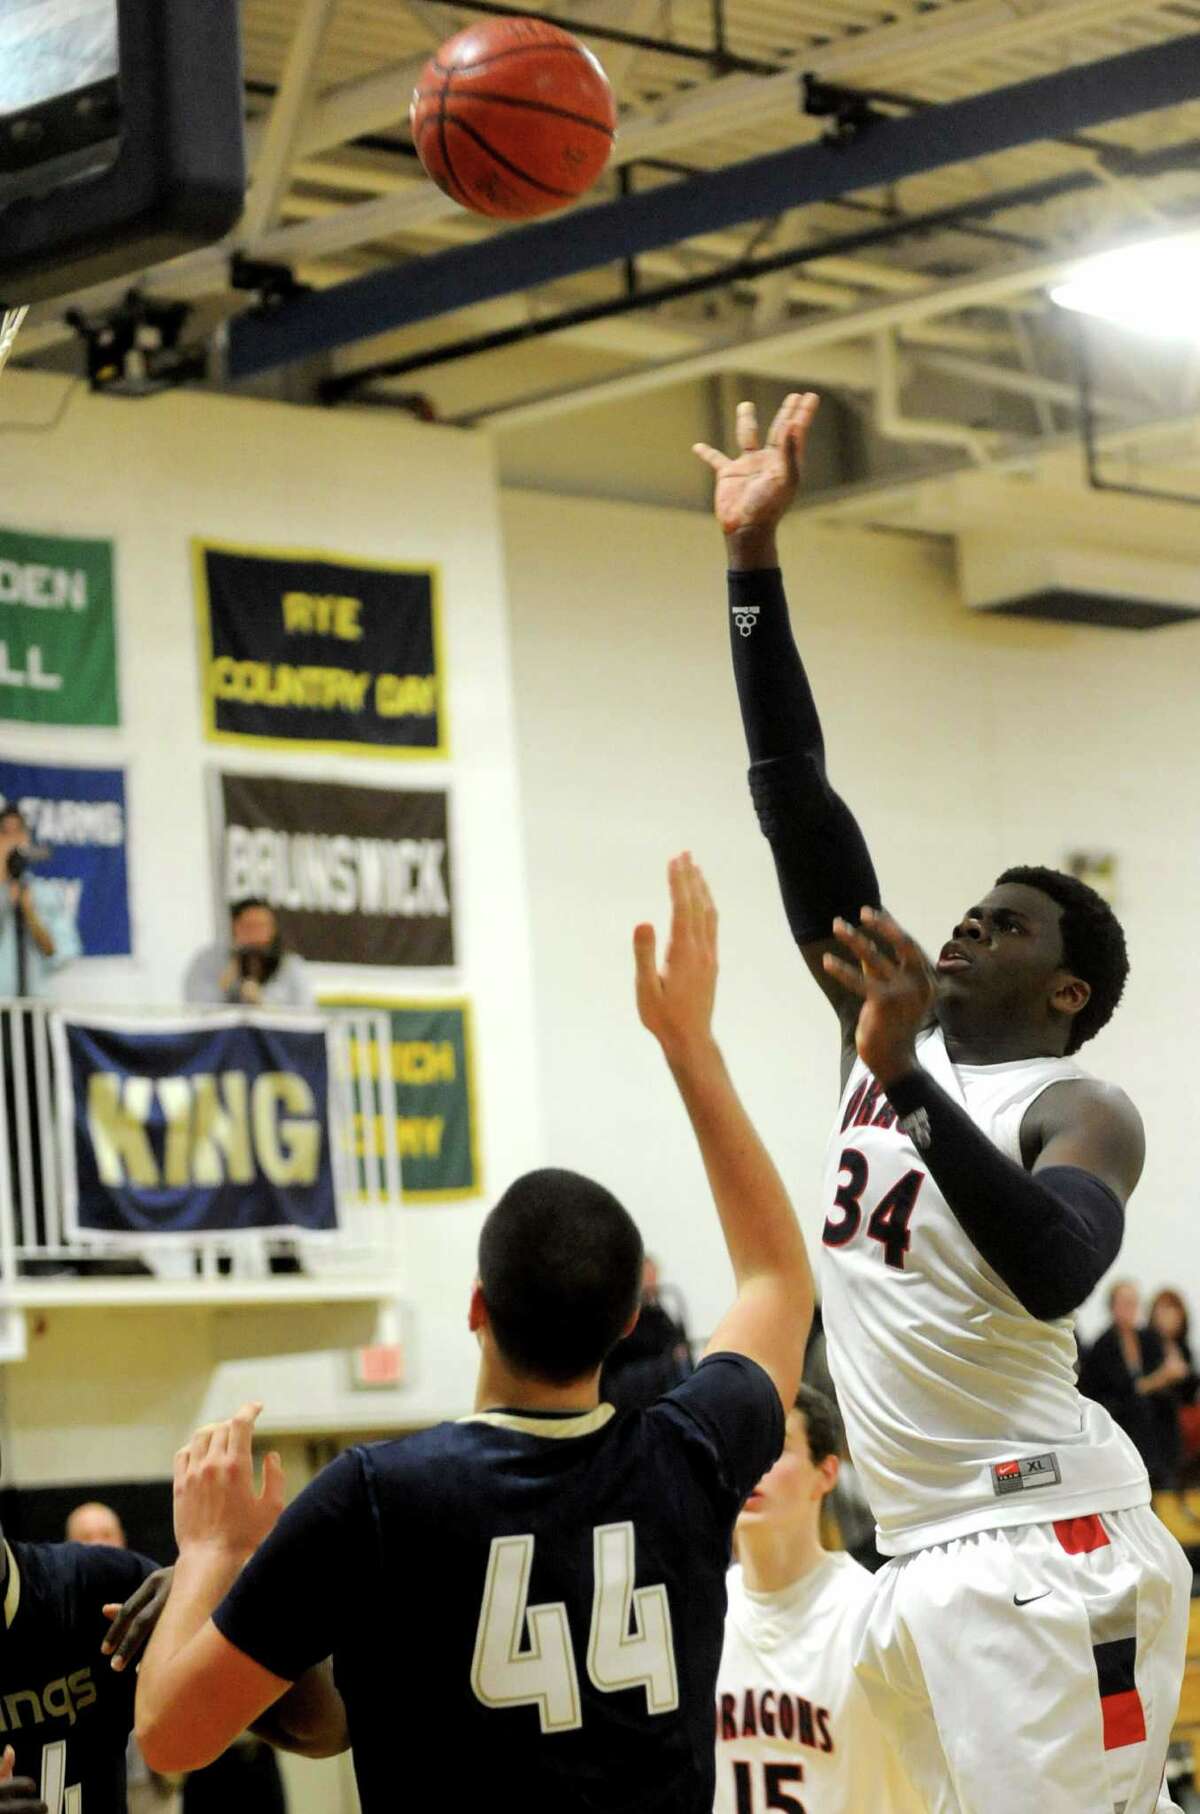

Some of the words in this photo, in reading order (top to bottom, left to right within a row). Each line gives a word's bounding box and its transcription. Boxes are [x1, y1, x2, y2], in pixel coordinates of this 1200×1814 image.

[283, 592, 362, 640] RYE
[212, 656, 370, 713] COUNTRY
[227, 824, 449, 917] BRUNSWICK
[87, 1070, 320, 1188] KING
[822, 1148, 925, 1269] 34
[1027, 1460, 1045, 1472] XL
[471, 1521, 679, 1734] 44
[716, 1689, 833, 1754] RAGONS
[732, 1761, 807, 1814] 15
